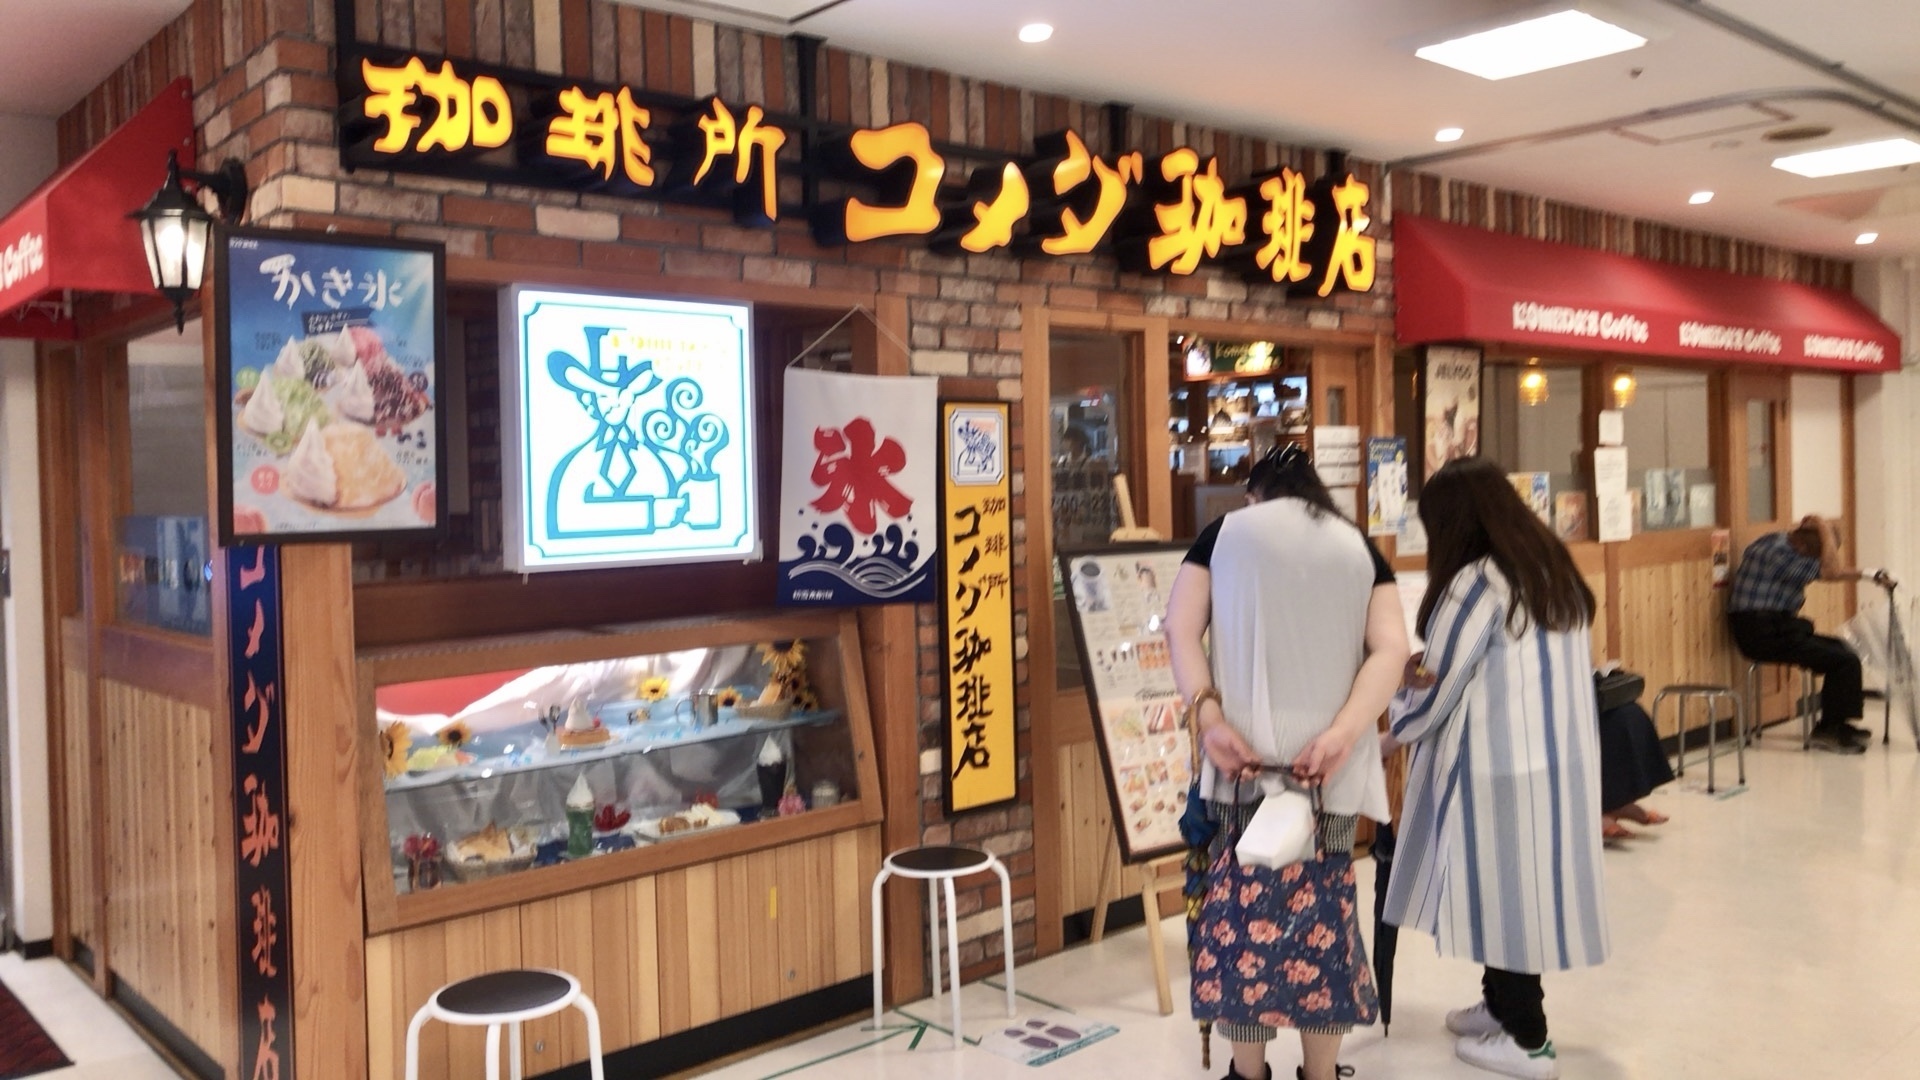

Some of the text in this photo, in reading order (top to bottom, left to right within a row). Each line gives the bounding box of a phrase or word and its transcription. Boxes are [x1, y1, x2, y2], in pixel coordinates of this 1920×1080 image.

[361, 56, 1377, 298] 珈琲所 コメダ珈琲店
[259, 253, 404, 311] かき氷
[1600, 311, 1649, 344] Coffee
[807, 415, 915, 536] 氷
[951, 505, 993, 782] コメダ珈琲店
